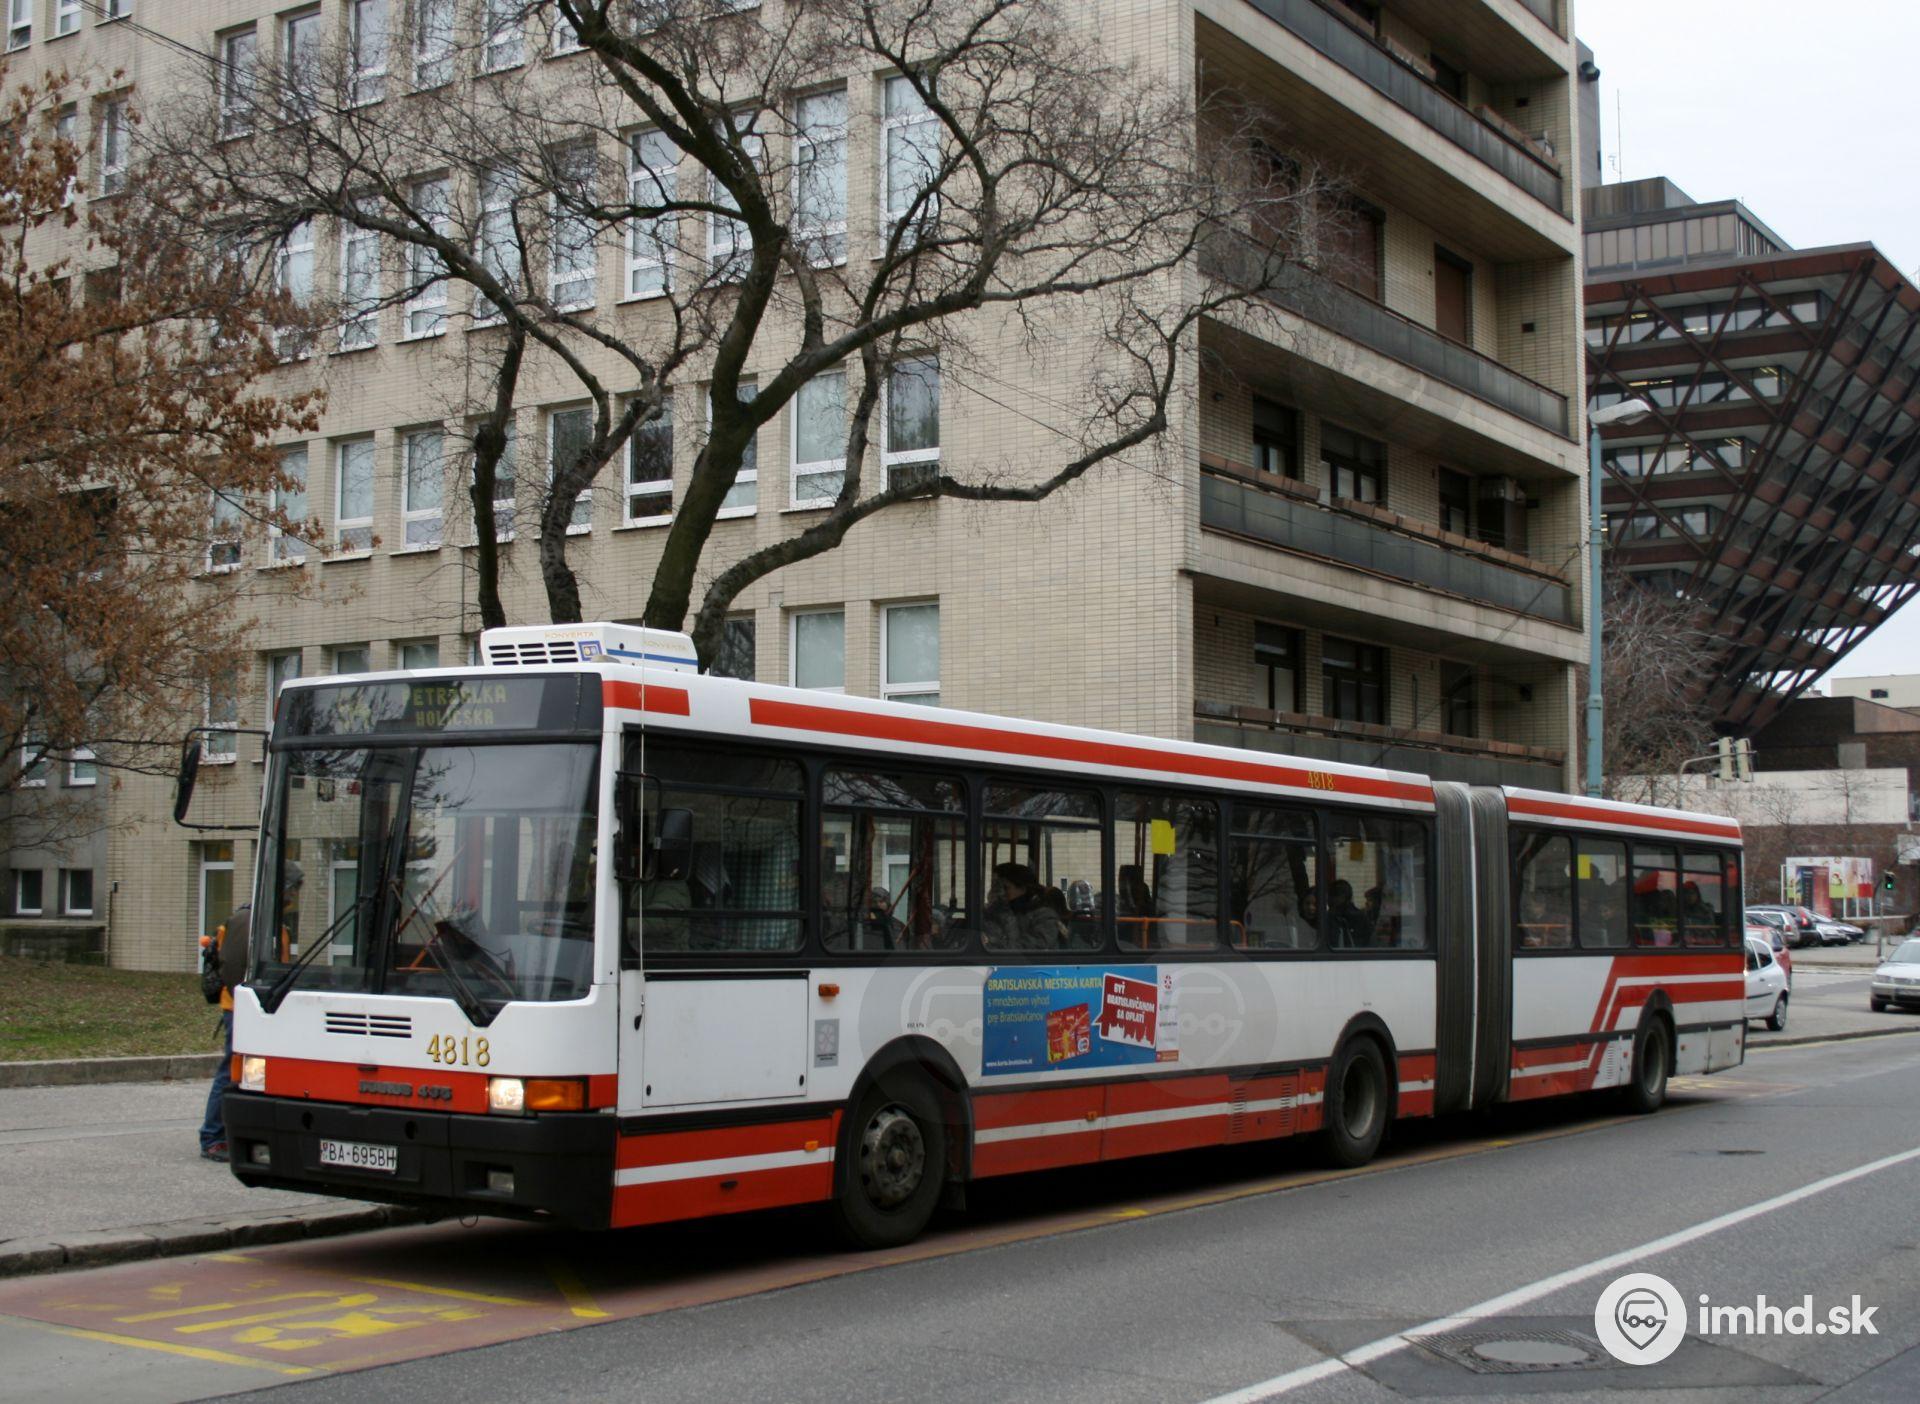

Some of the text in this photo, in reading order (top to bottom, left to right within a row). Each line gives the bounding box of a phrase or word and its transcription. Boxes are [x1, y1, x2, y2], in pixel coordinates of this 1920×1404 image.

[1308, 771, 1335, 791] 4818
[426, 1034, 491, 1067] 4818
[328, 1143, 397, 1168] BA-695BH
